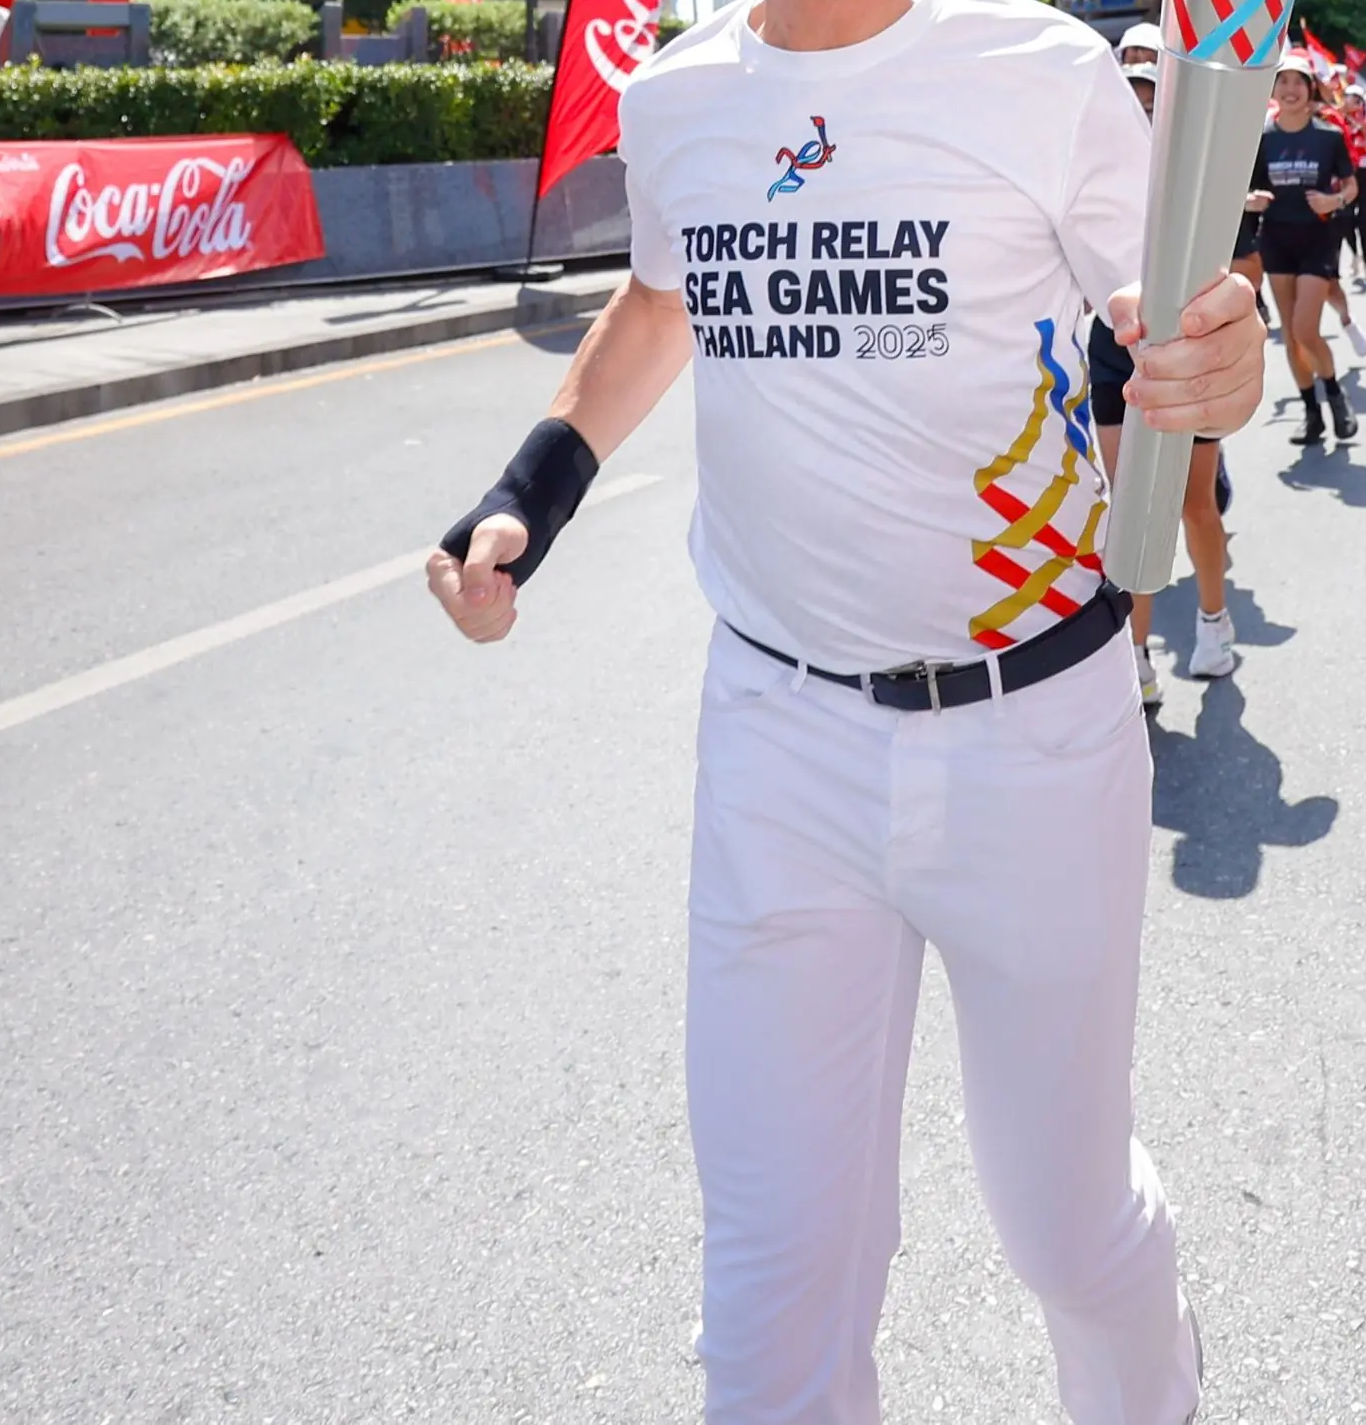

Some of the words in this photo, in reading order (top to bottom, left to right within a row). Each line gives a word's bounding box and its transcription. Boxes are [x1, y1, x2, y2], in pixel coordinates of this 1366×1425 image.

[46, 157, 257, 267] Coca-Cola
[682, 222, 798, 263] TORCH
[811, 220, 950, 260] RELAY
[685, 271, 753, 316] SEA
[767, 268, 949, 315] GAMES
[691, 324, 841, 359] THAILAND
[853, 323, 950, 360] 2025
